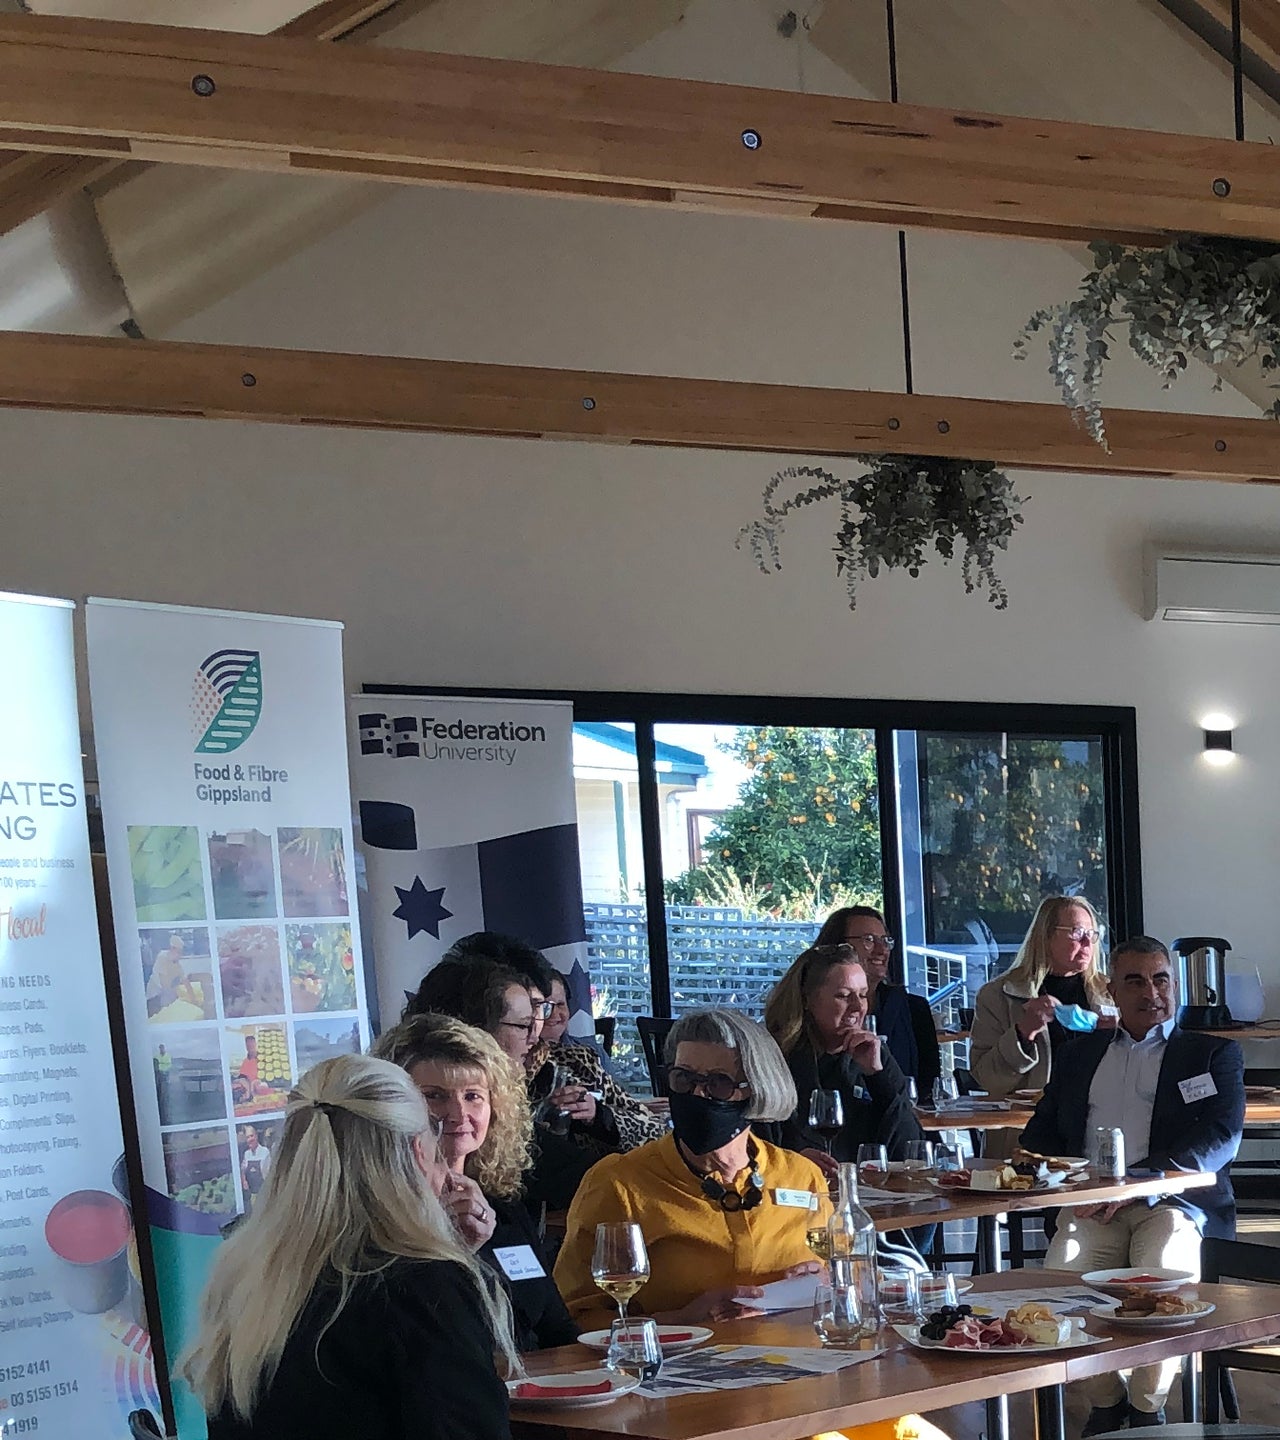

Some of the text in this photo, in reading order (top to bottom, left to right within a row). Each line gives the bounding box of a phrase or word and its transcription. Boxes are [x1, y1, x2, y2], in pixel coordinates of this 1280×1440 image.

[421, 717, 545, 742] Federation
[423, 742, 516, 766] University
[194, 763, 289, 783] Food & Fibre
[196, 784, 272, 806] Gippsland
[19, 974, 51, 988] NEEDS
[27, 1359, 51, 1376] 4141
[11, 1391, 25, 1408] 03
[26, 1386, 52, 1404] 5155
[53, 1379, 79, 1398] 1514
[13, 1416, 39, 1435] 1919
